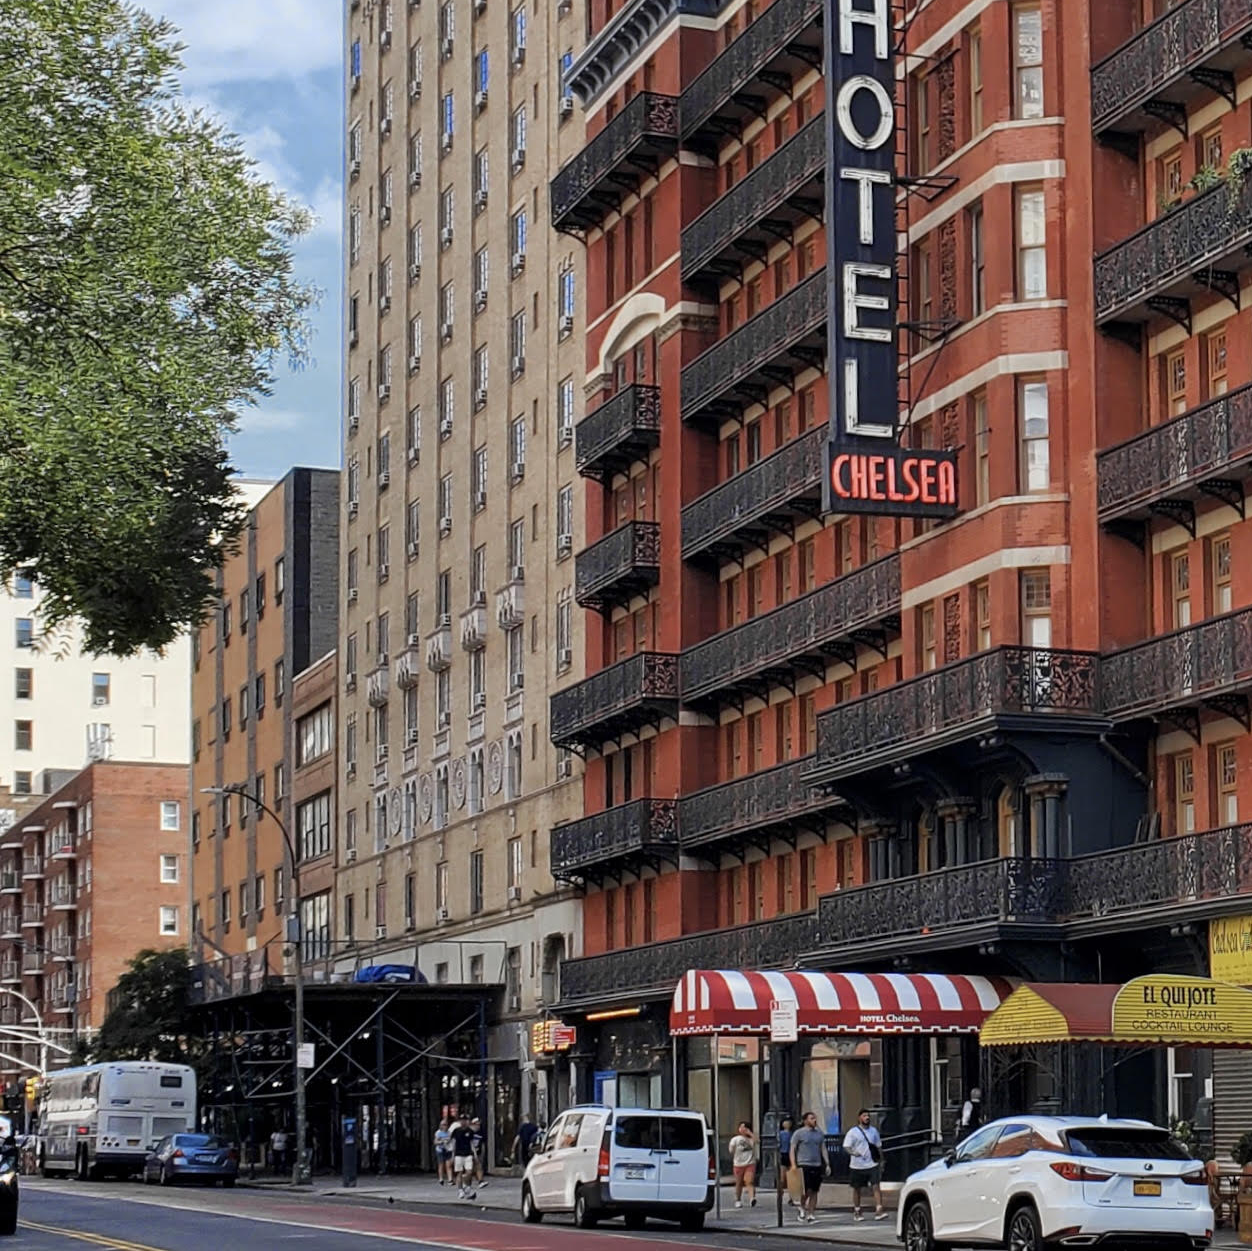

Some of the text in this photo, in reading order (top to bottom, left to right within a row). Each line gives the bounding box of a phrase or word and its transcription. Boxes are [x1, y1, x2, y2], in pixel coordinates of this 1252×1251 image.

[831, 454, 956, 504] CHELSEA
[1143, 985, 1217, 1008] EL QUIJOTE
[860, 1014, 920, 1023] HOTEL Chelsea
[1145, 1009, 1217, 1020] RESTAURANT
[1132, 1020, 1233, 1033] COCKTAIL LOUNGE
